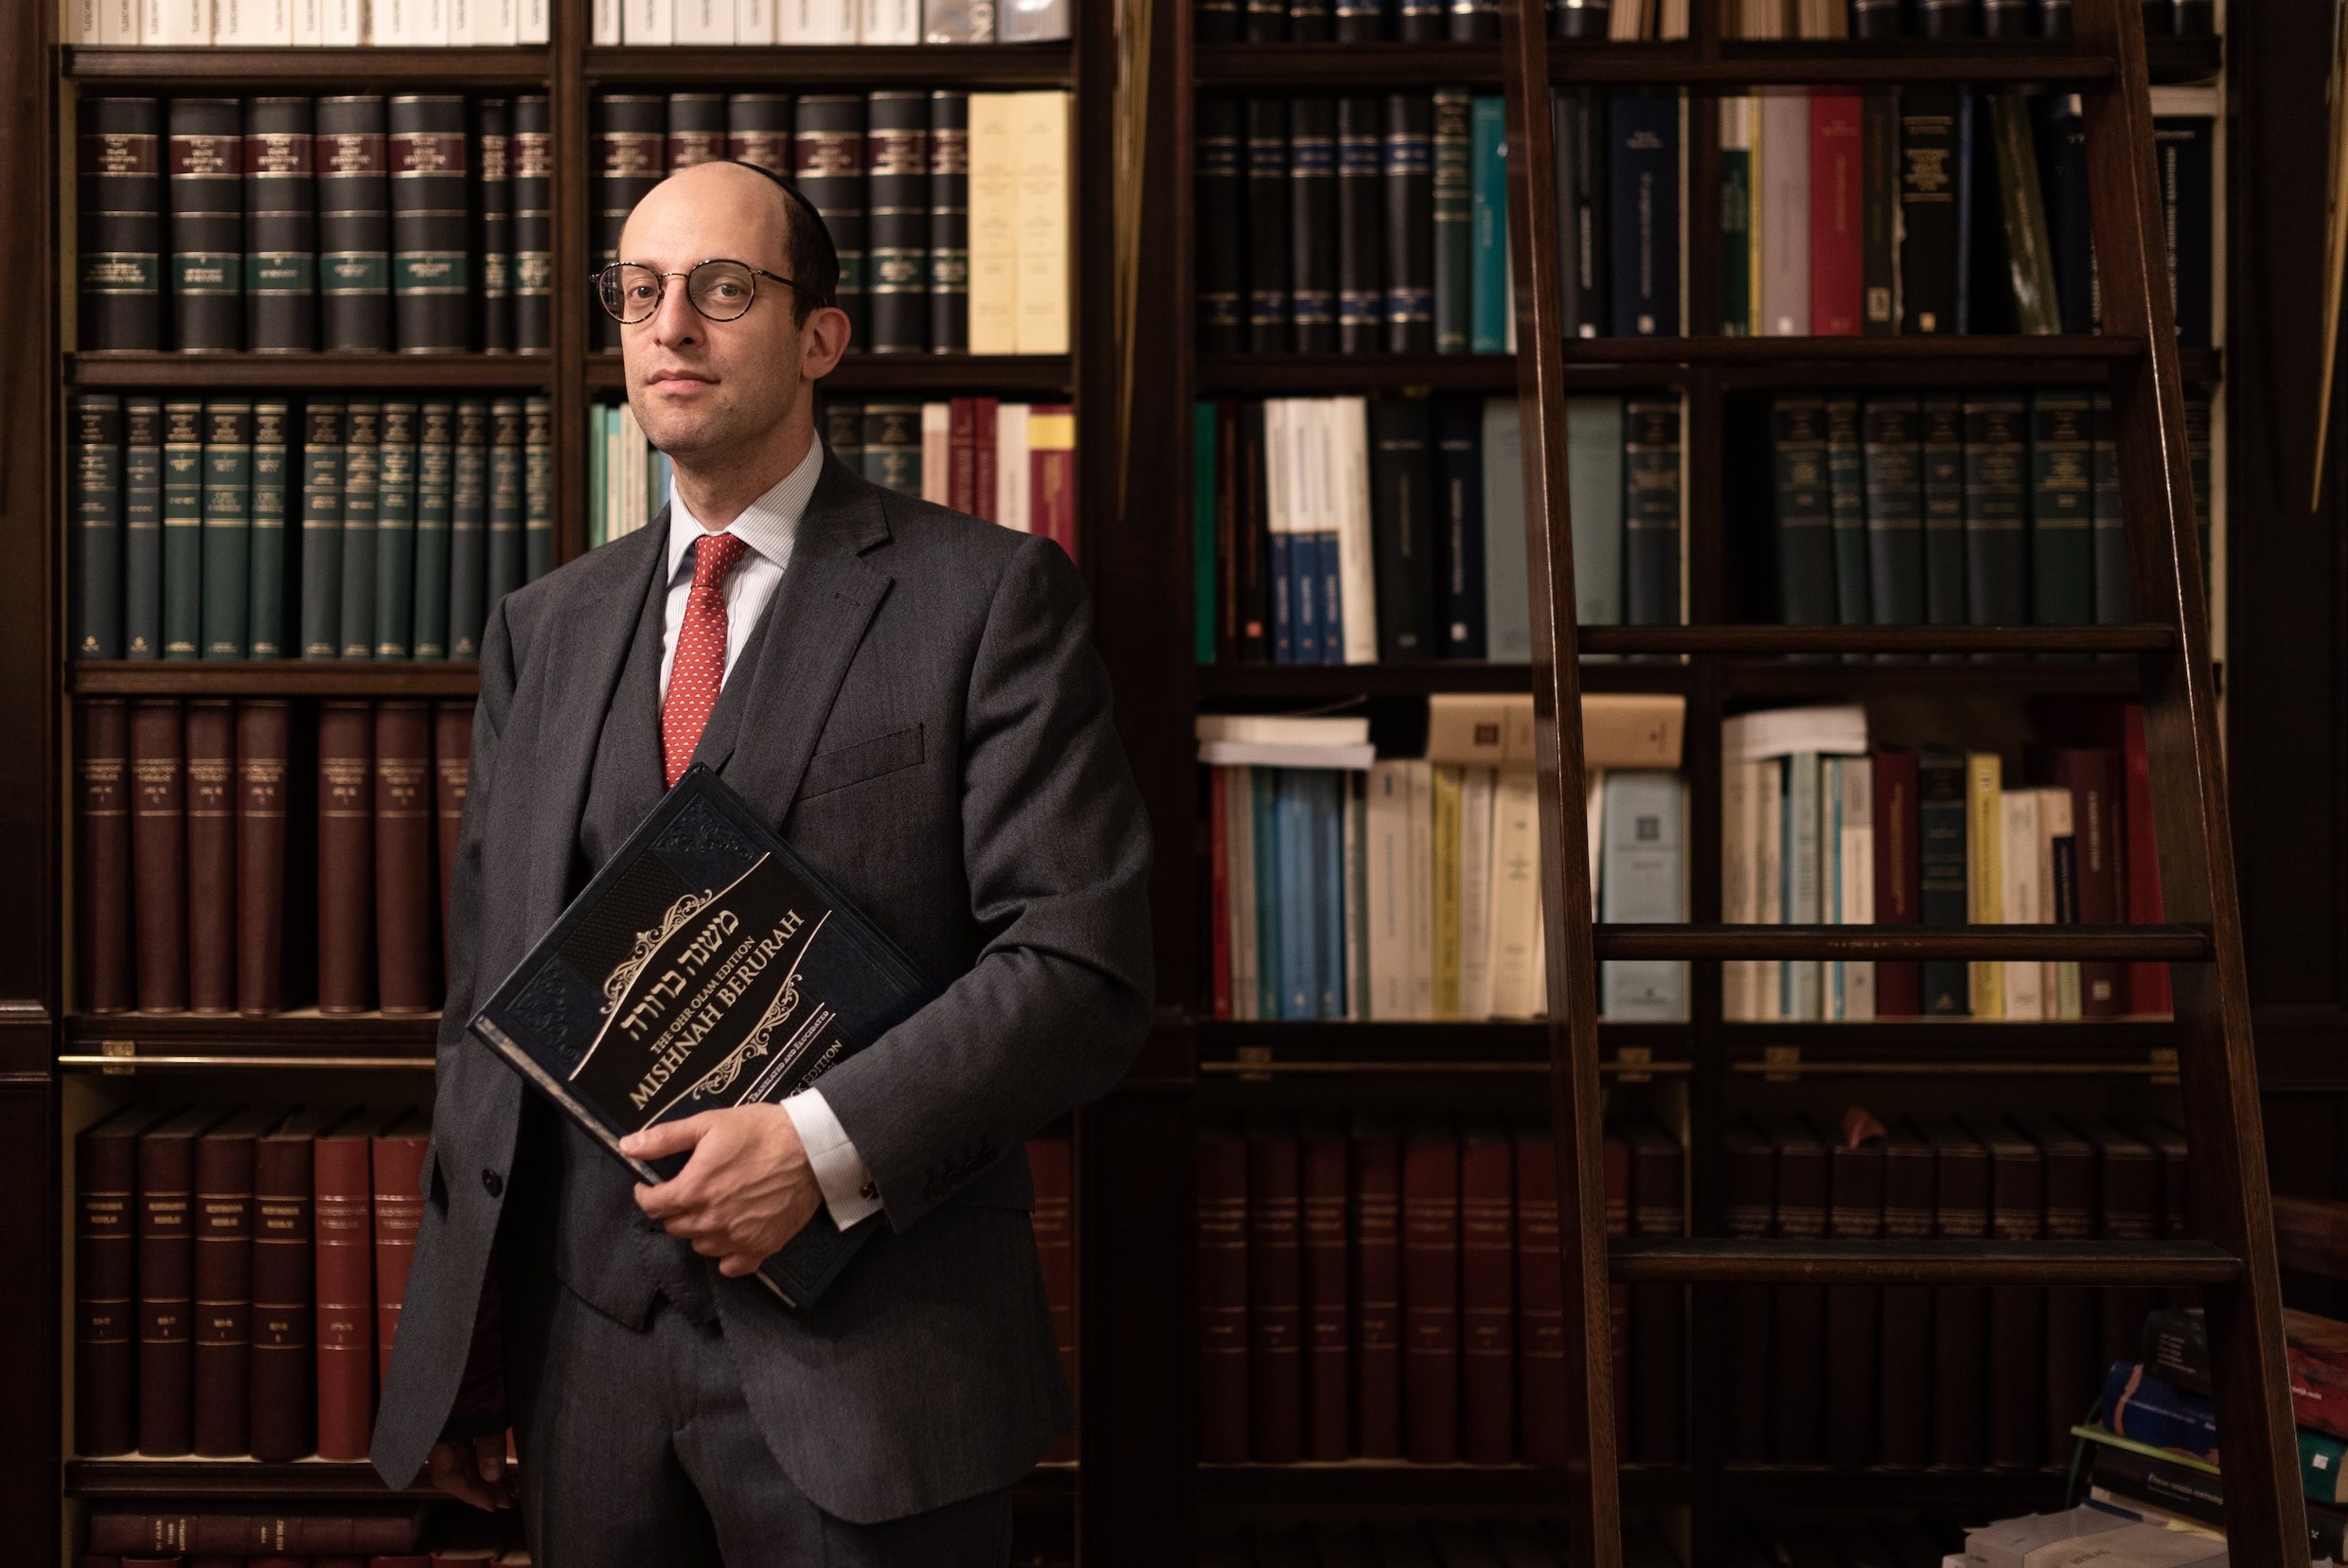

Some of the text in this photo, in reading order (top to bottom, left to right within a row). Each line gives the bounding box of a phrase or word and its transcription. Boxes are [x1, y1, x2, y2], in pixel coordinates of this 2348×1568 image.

[620, 909, 739, 1041] משנה ברורה
[629, 909, 805, 1111] MISHNAH BERURAH
[649, 935, 756, 1054] THE OHR OLAM EDITION
